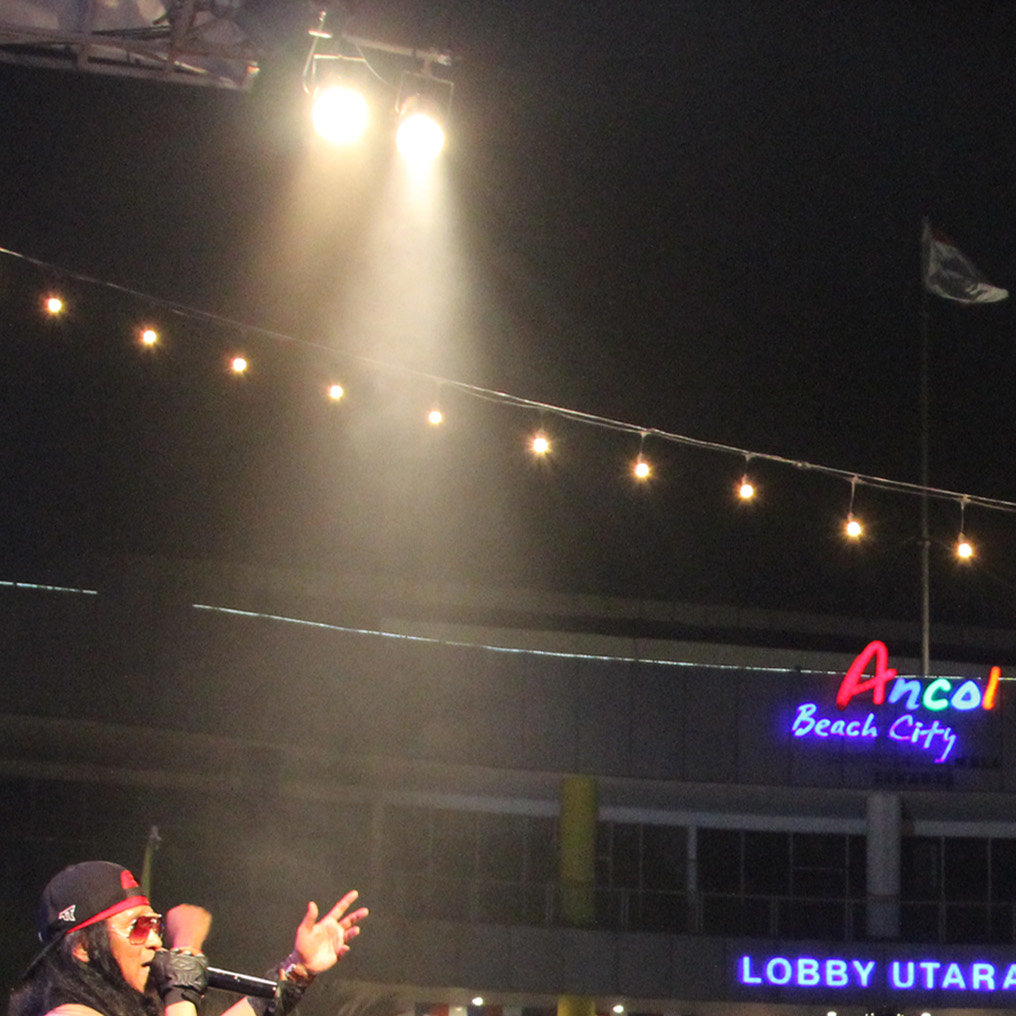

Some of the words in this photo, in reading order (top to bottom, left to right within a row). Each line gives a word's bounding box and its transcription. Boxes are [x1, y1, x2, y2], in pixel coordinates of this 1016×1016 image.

[836, 640, 1001, 711] Ancol
[791, 702, 878, 738] Beach
[888, 714, 958, 764] City
[740, 954, 876, 988] LOBBY
